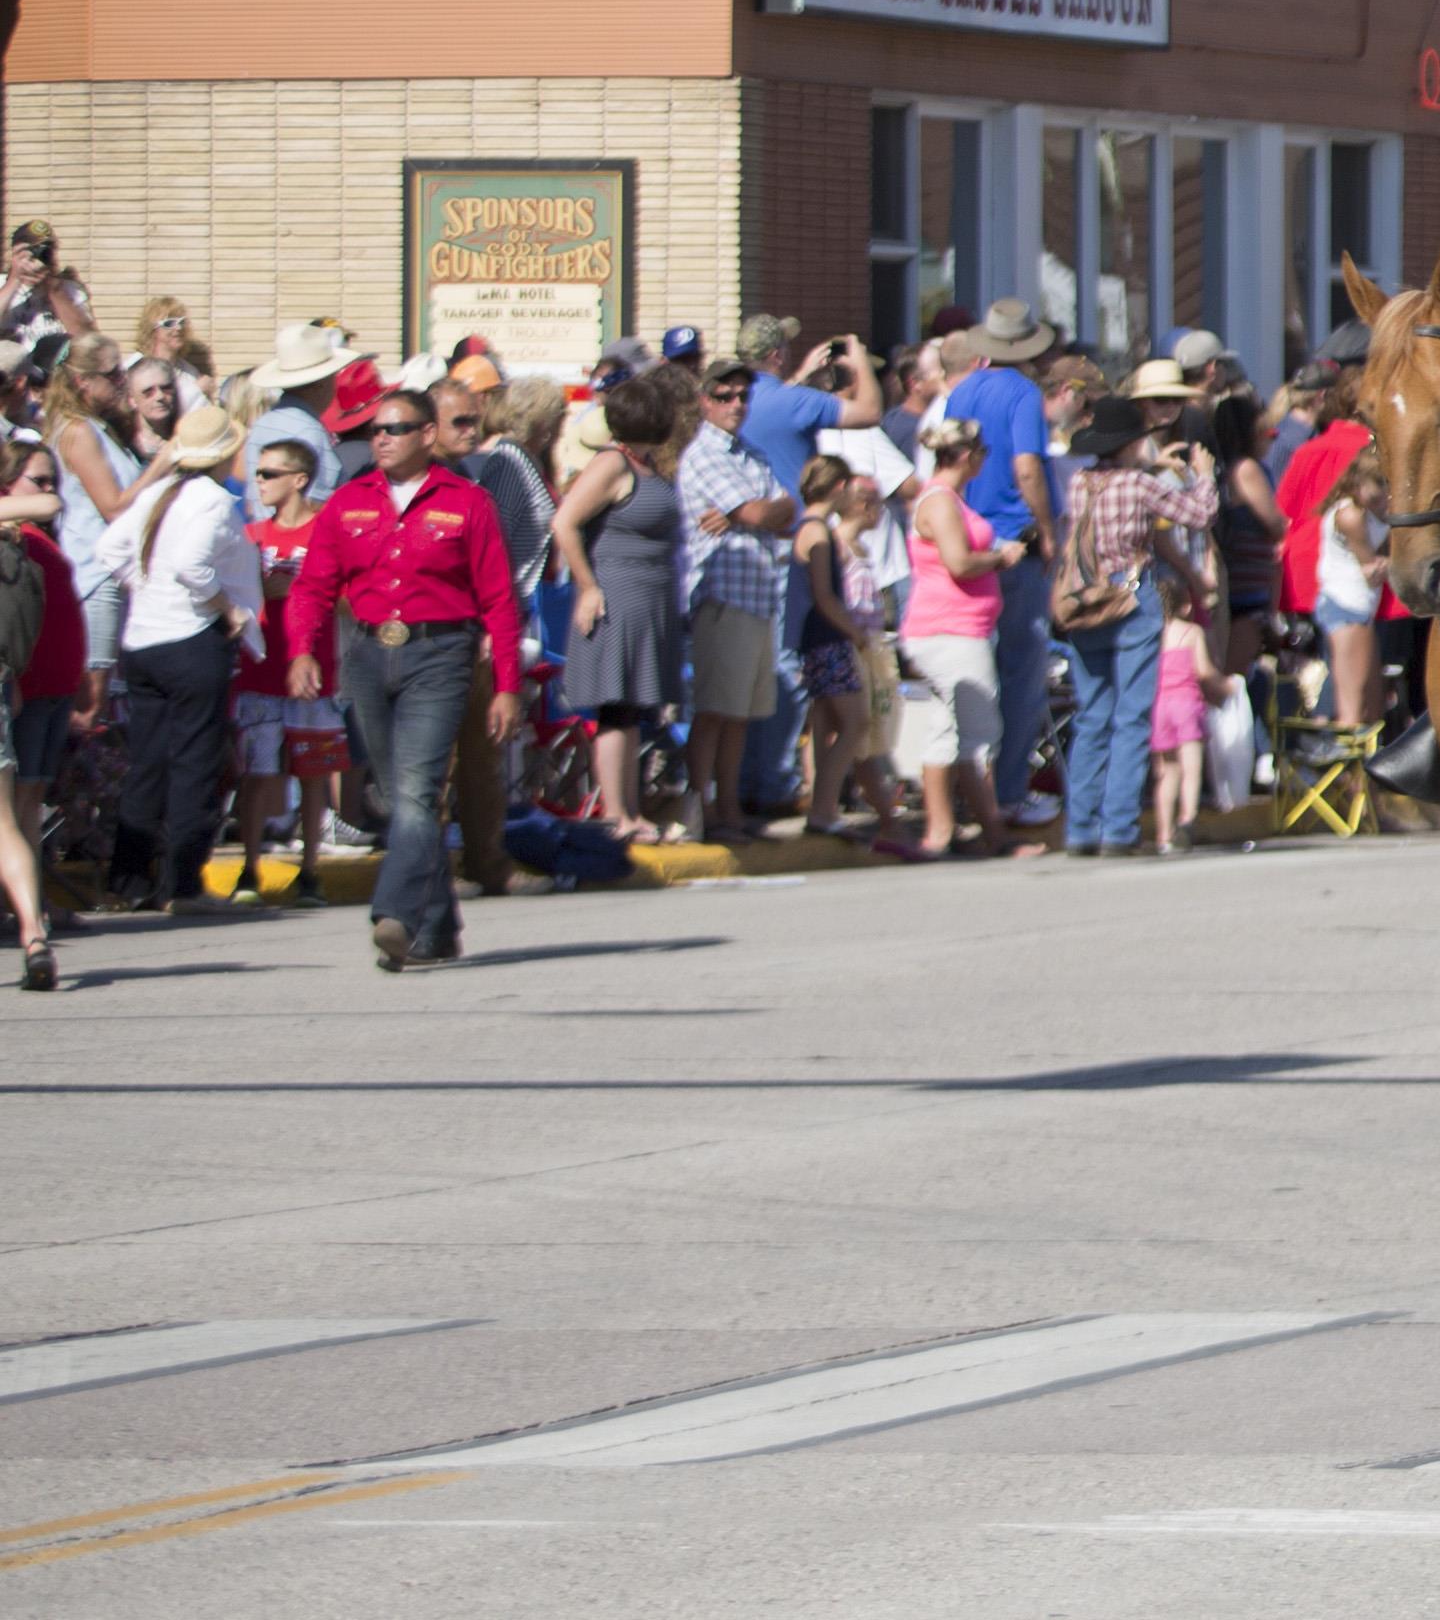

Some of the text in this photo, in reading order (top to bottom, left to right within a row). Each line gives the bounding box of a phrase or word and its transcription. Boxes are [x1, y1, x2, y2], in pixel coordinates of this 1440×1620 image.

[444, 197, 595, 240] SPONSORS
[431, 237, 612, 280] GUNFIGHTERS
[485, 242, 552, 257] CODY
[511, 308, 592, 318] BEVERAGES
